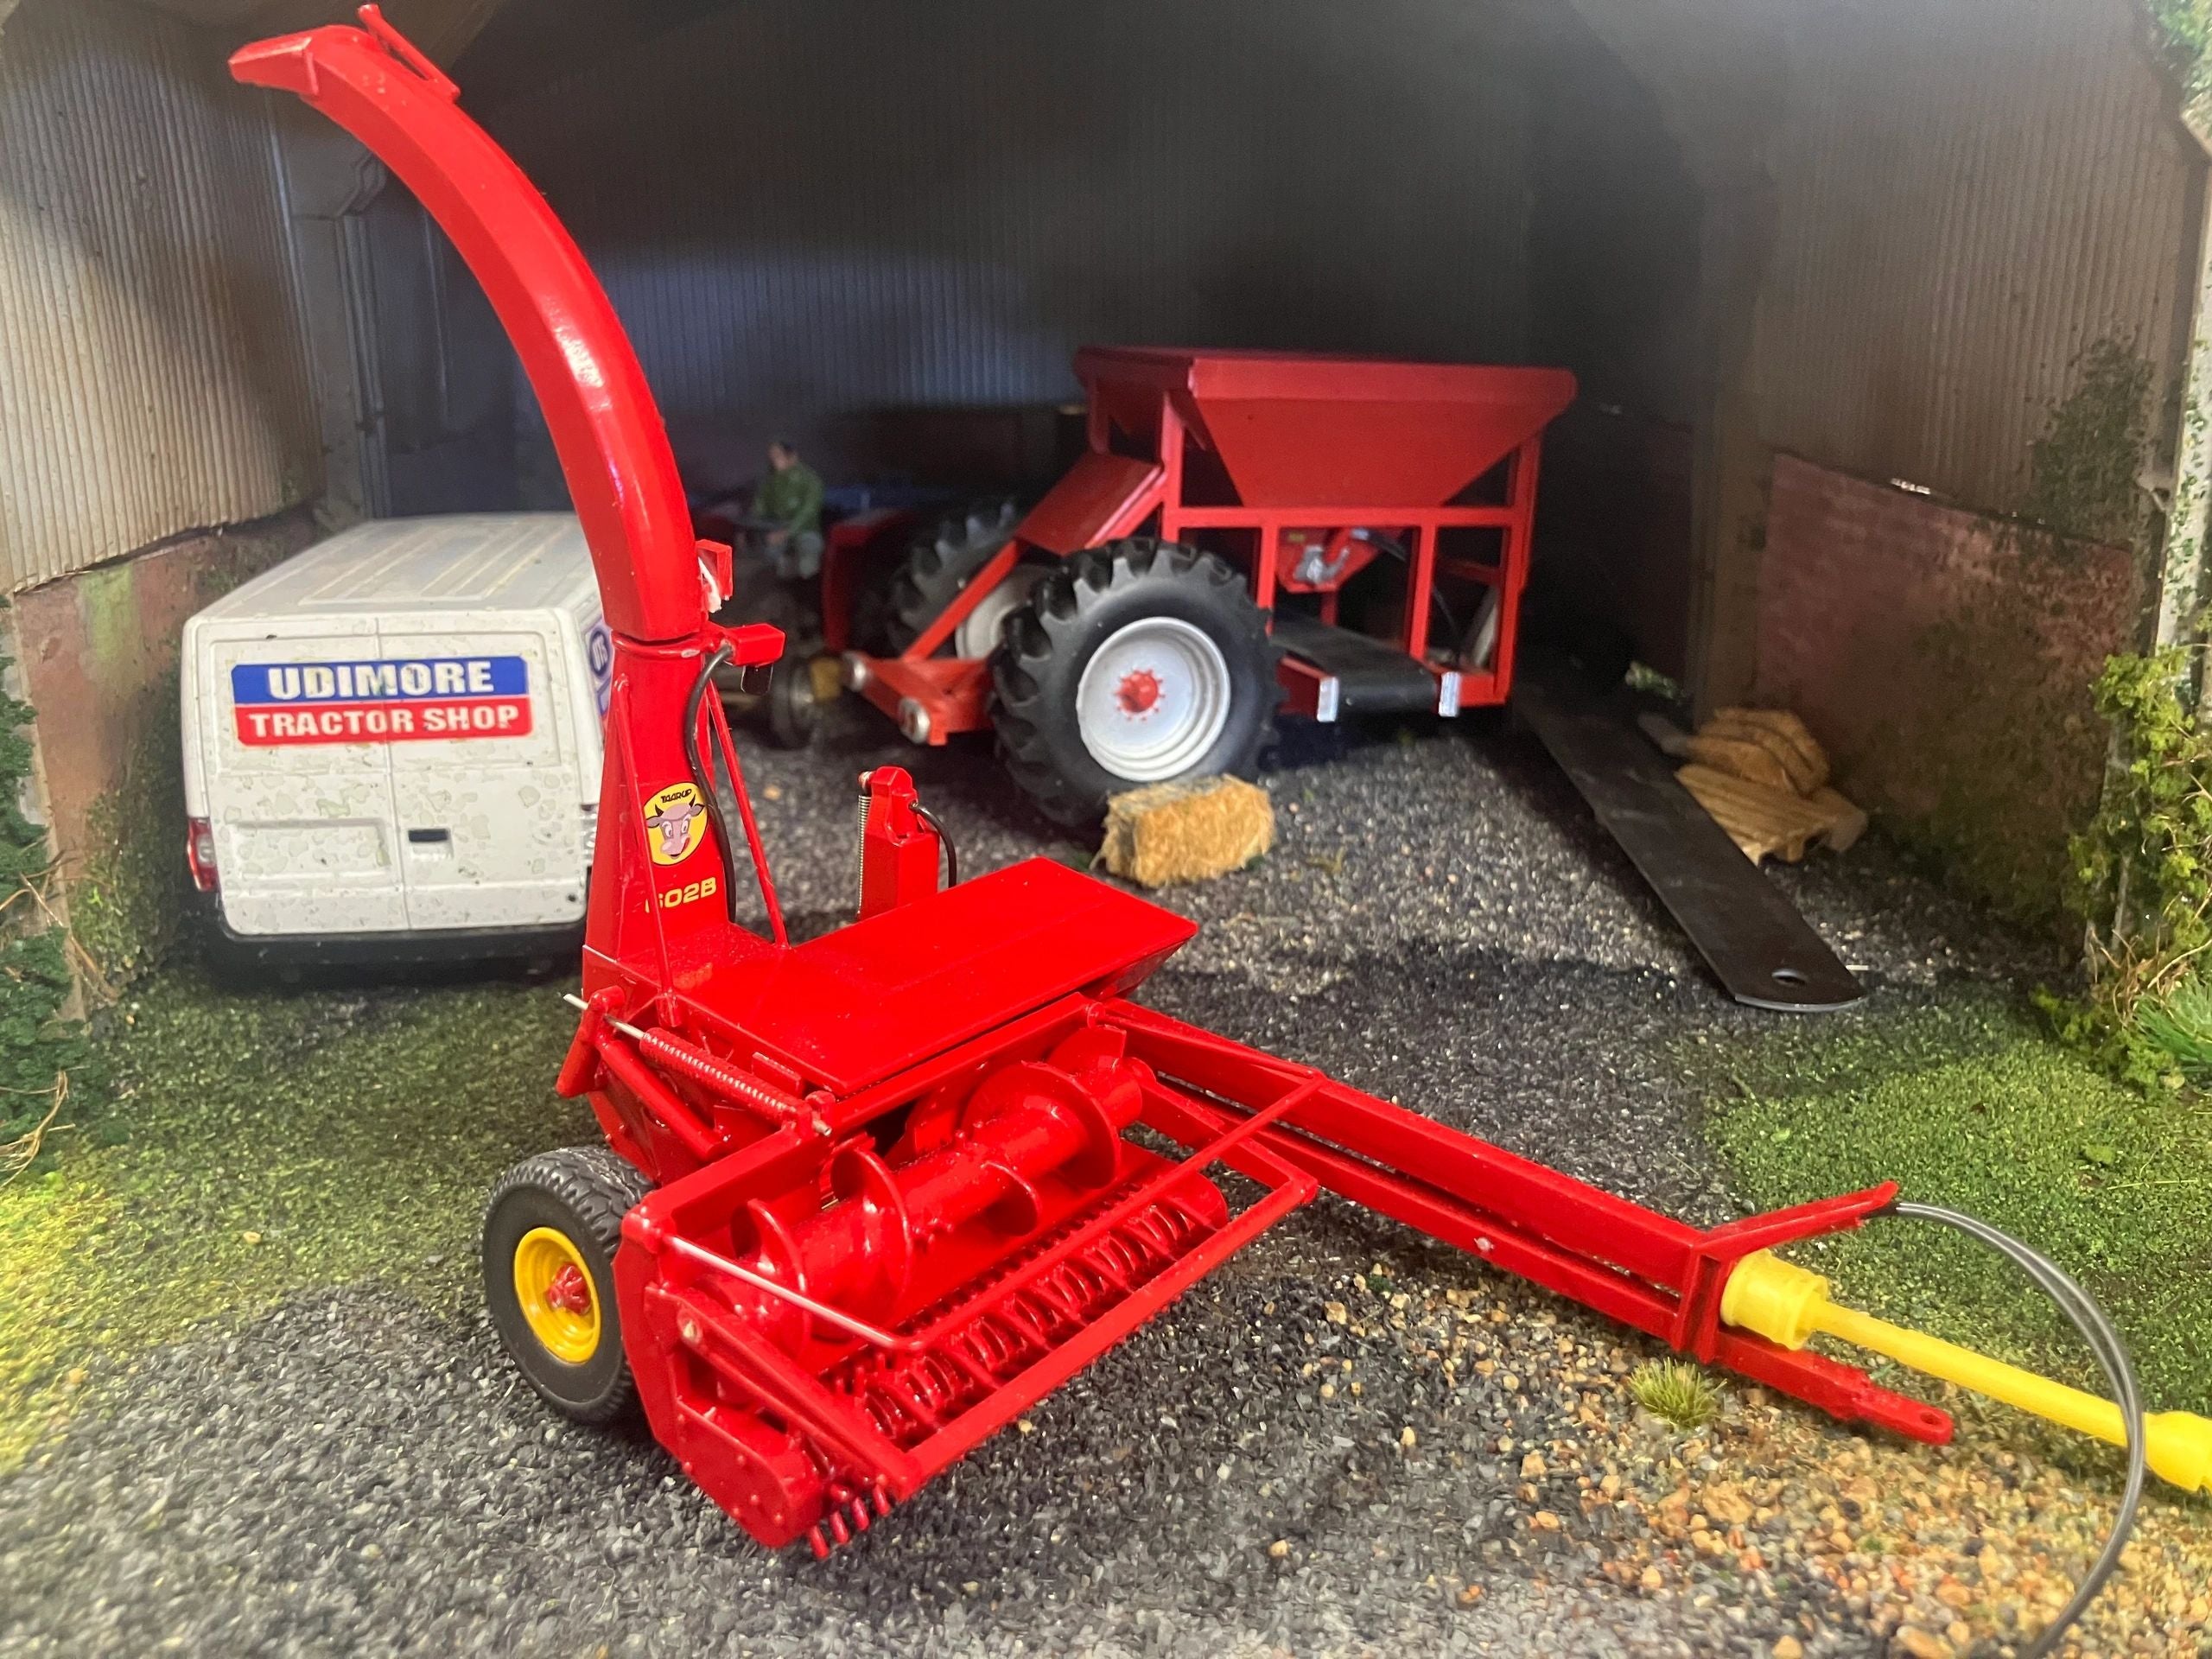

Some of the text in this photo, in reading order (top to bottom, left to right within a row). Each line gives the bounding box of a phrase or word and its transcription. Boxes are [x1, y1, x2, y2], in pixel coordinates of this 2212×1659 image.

[268, 662, 494, 700] UDIMORE
[249, 705, 519, 738] TRACTOR SHOP
